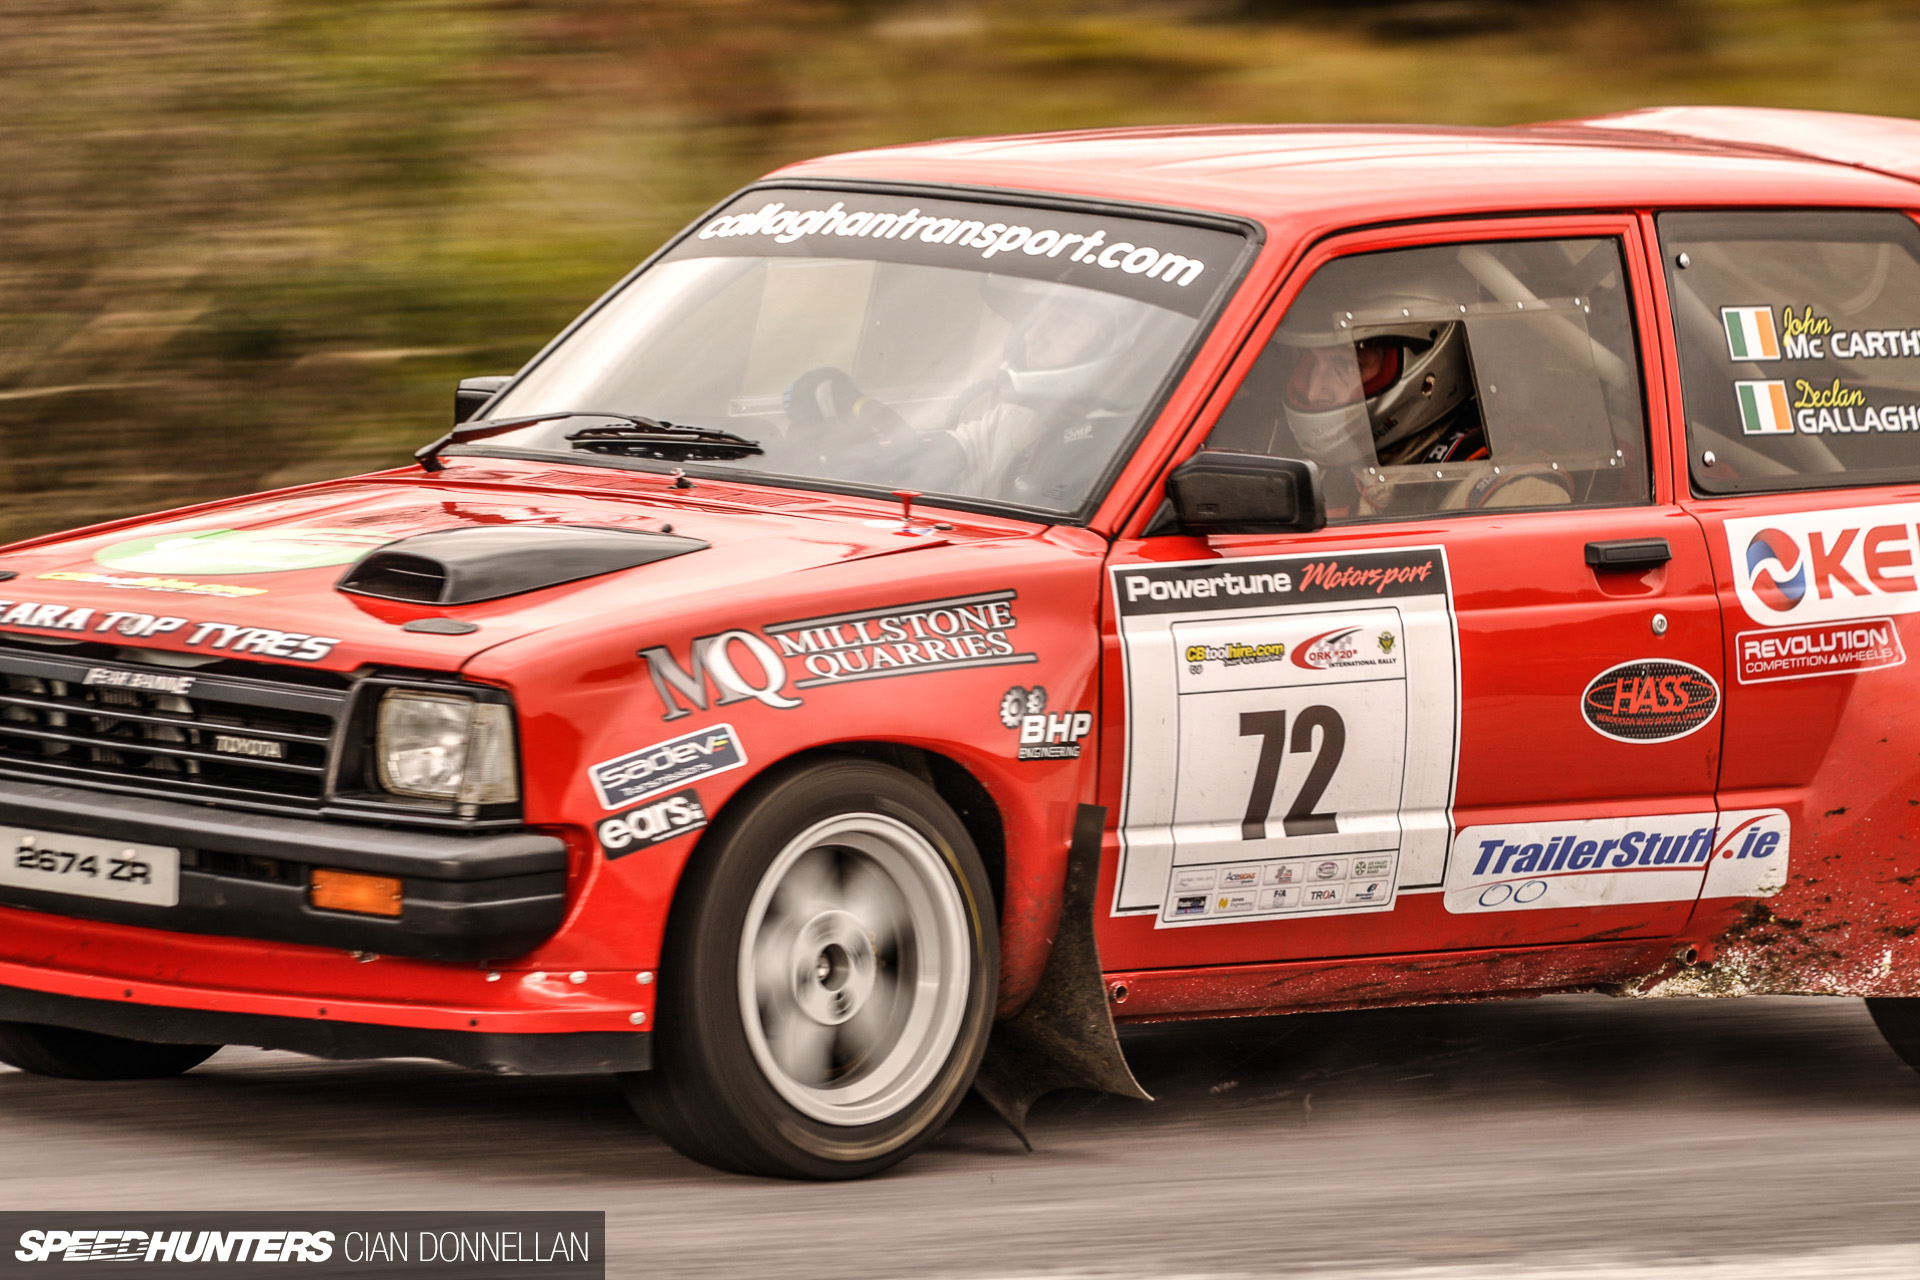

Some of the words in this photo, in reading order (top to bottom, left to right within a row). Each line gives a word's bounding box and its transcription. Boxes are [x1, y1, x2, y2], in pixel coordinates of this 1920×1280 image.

[698, 202, 1205, 287] callaghantransport.com
[1783, 306, 1832, 347] John
[1785, 333, 1824, 359] Mc
[1831, 329, 1920, 358] CARTH
[1794, 377, 1866, 409] Declan
[1797, 405, 1920, 434] GALLAGH
[1125, 572, 1292, 602] Powertune
[1299, 560, 1432, 594] Motorsport
[1808, 523, 1920, 600] KE
[95, 611, 189, 637] TOP
[186, 622, 342, 661] TYRES
[773, 600, 1016, 658] MILLSTONE
[1745, 628, 1889, 660] REVOLUTION
[804, 631, 1014, 680] QUARRIES
[1186, 643, 1285, 662] CBtoolhire.com
[1329, 659, 1376, 668] INTERNATIONAL
[1746, 655, 1829, 674] COMPETITION
[1838, 647, 1894, 664] WHEELS
[638, 628, 803, 722] MQ
[1612, 675, 1692, 715] HASS
[1020, 712, 1092, 744] BHP
[1597, 714, 1635, 725] HENDERSON
[600, 735, 717, 789] sadev
[1018, 746, 1081, 759] ENGINEERING
[1239, 704, 1345, 841] 72
[598, 796, 694, 849] ears
[15, 847, 99, 878] 2674
[106, 858, 152, 885] ZR
[1311, 890, 1336, 900] TROA
